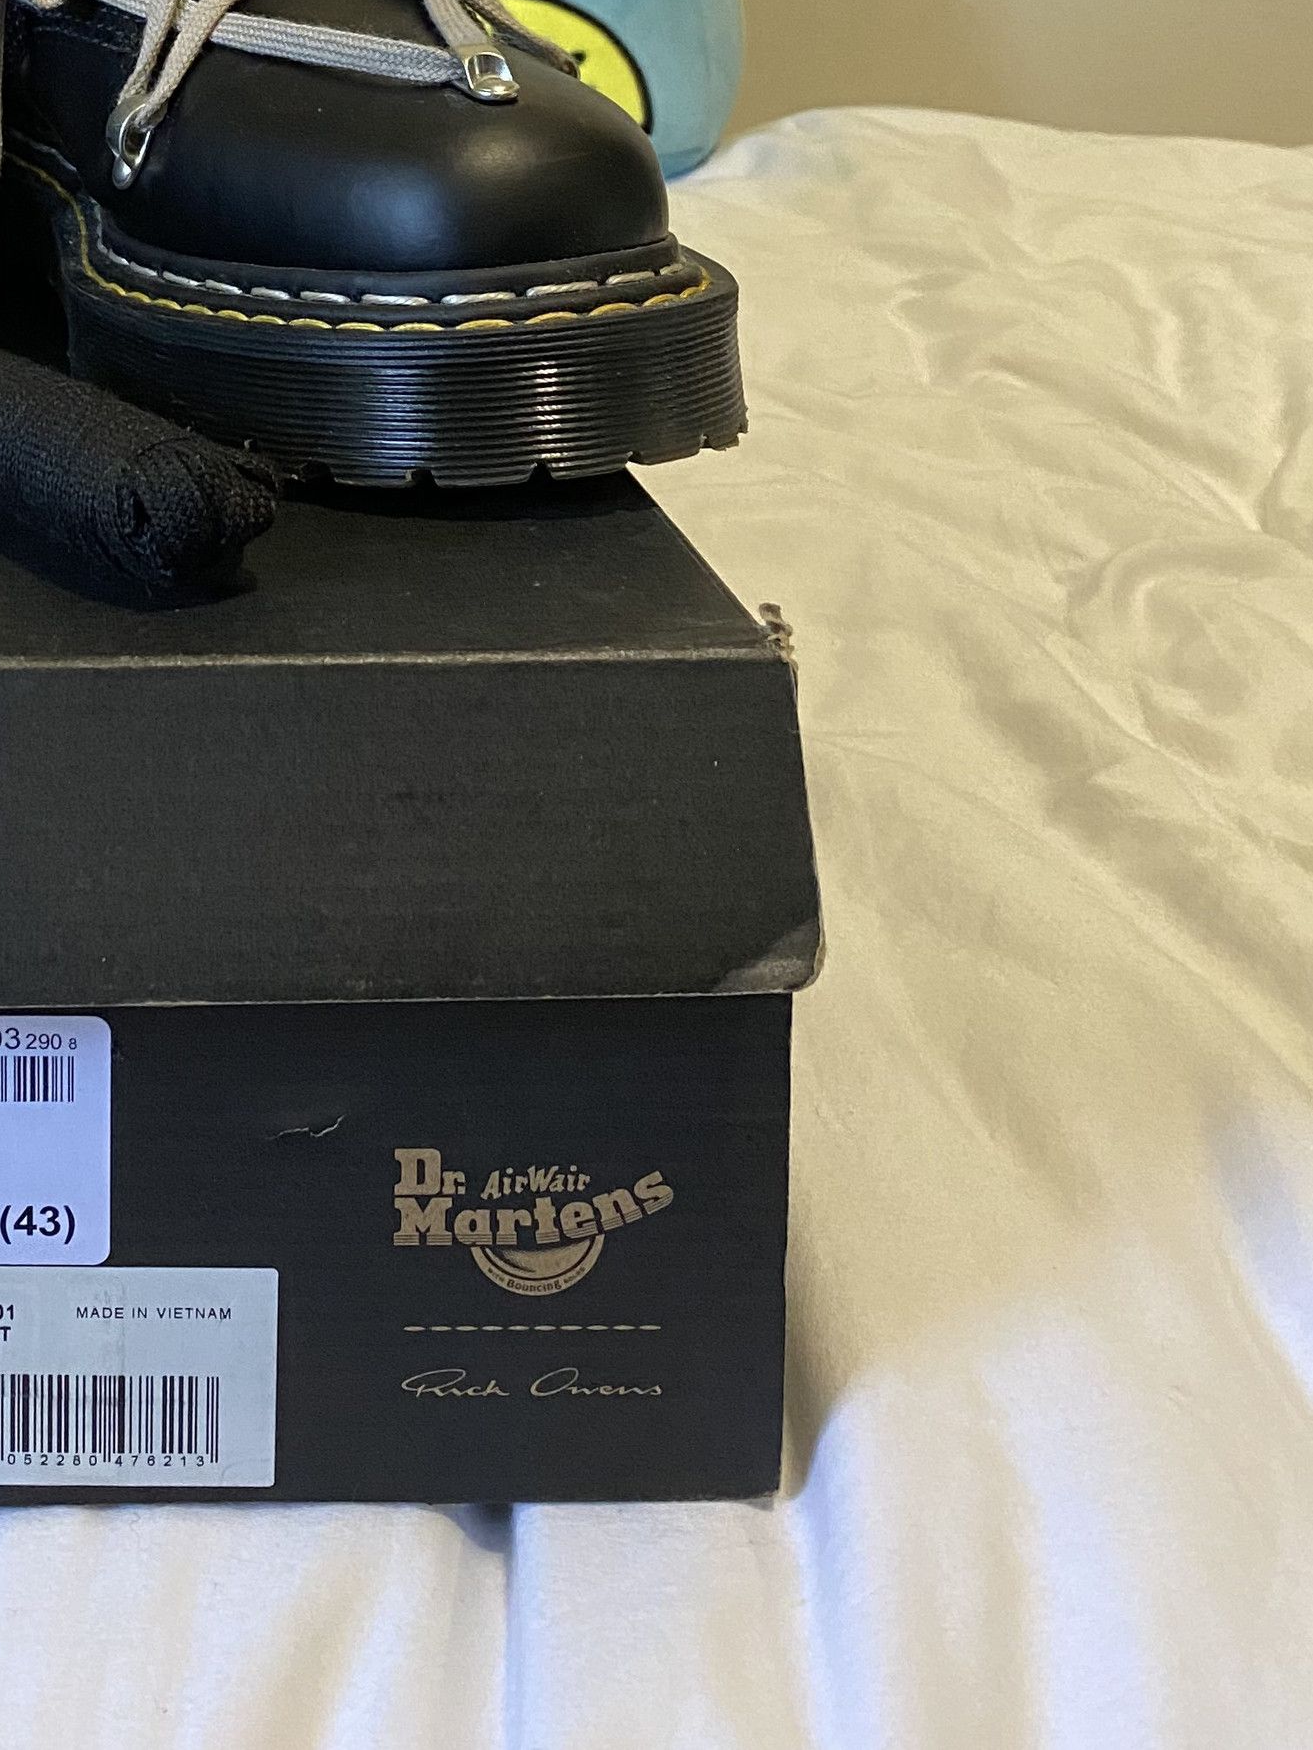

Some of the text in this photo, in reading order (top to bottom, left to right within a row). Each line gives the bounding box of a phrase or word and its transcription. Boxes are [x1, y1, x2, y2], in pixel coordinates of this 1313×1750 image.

[393, 1147, 466, 1196] Dr.
[480, 1165, 591, 1200] AirWair
[0, 1204, 76, 1245] (43)
[393, 1170, 674, 1246] Martens
[76, 1306, 232, 1320] MADE IN VIETNAM
